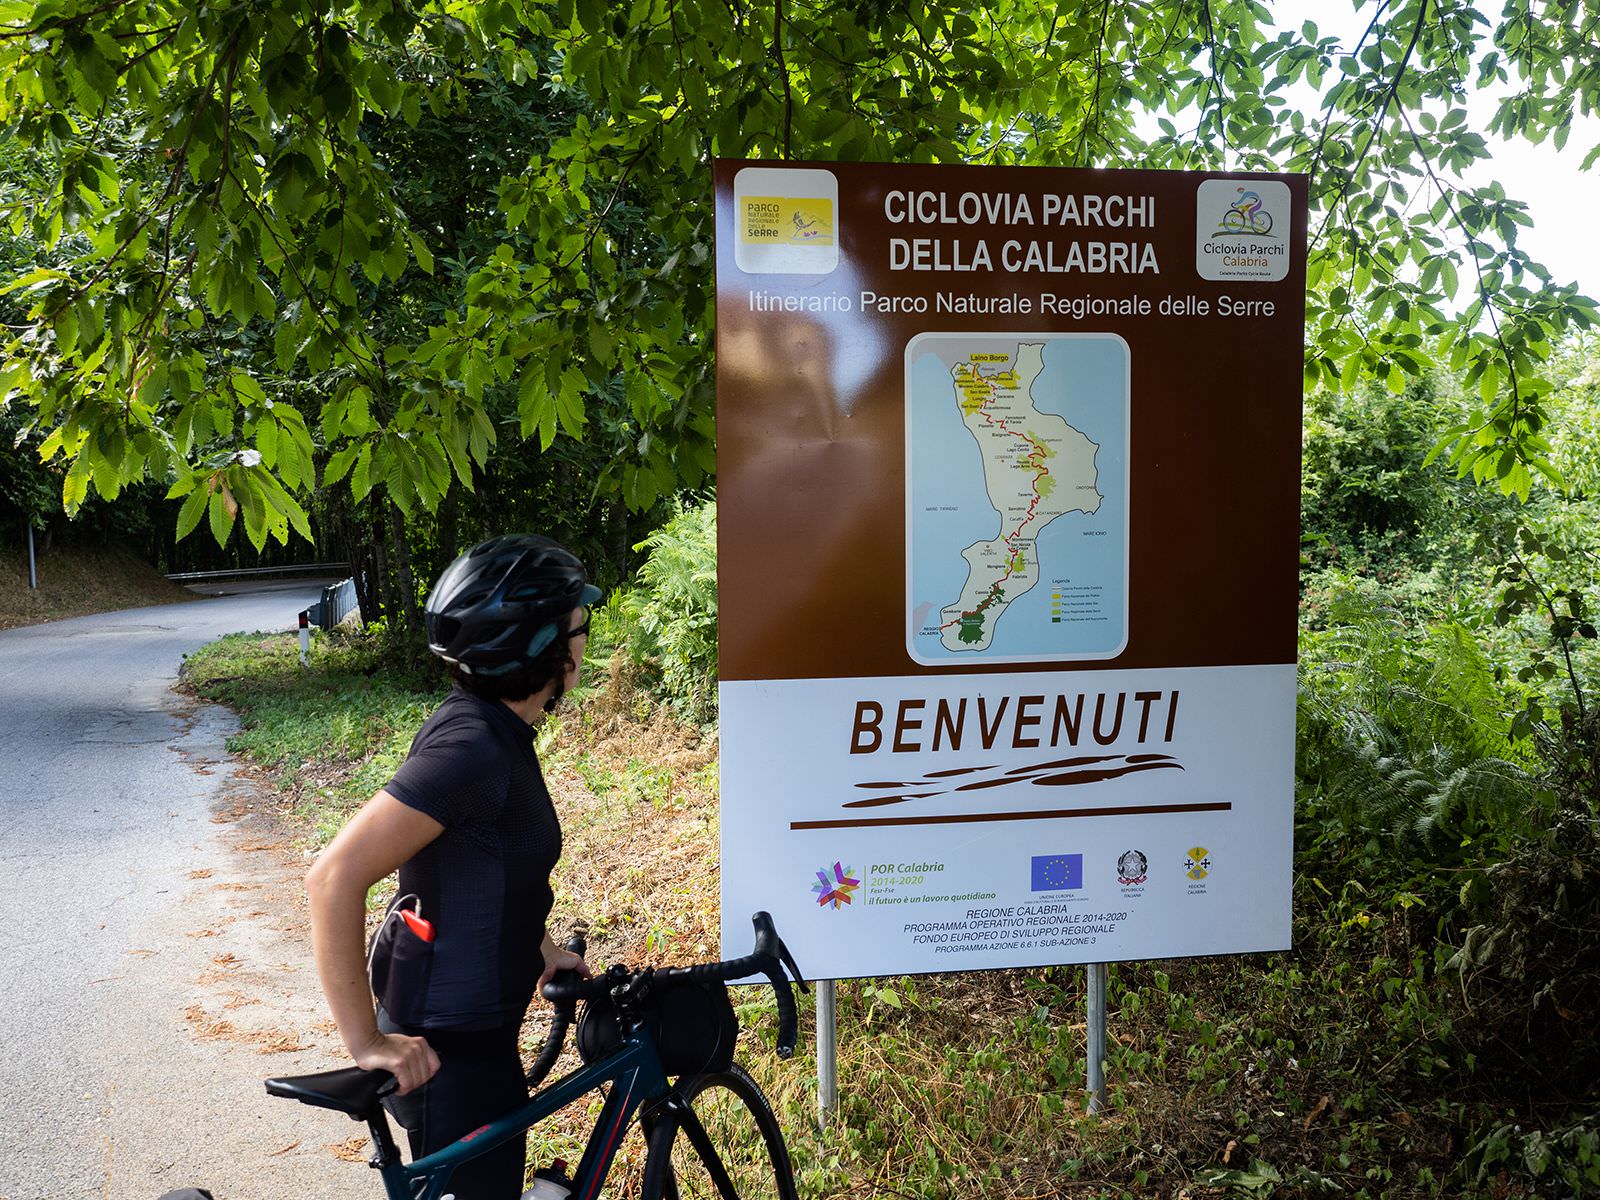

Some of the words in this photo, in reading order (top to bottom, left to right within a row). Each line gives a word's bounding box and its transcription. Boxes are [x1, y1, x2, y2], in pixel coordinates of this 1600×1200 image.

[885, 190, 1034, 226] CICLOVIA
[1043, 193, 1155, 228] PARCHI
[890, 238, 993, 272] DELLA
[1002, 239, 1160, 275] CALABRIA
[1204, 242, 1247, 254] Ciclovia
[1250, 244, 1284, 255] Parchi
[1223, 256, 1268, 267] Calabria
[750, 290, 851, 313] Itinerario
[861, 292, 928, 314] Parco
[936, 292, 1032, 315] Naturale
[1040, 294, 1151, 320] Regionale
[1159, 295, 1210, 317] delle
[1217, 296, 1275, 317] Serre
[849, 690, 1180, 755] BENVENUTI
[870, 864, 895, 874] POR
[897, 862, 944, 874] Calabria
[870, 876, 924, 886] 2014-2020
[874, 897, 902, 905] futuro
[922, 894, 950, 902] lavoro
[950, 892, 996, 902] quotidiano
[966, 908, 1014, 920] REGIONE
[1016, 904, 1068, 916] CALABRIA
[904, 922, 968, 933] PROGRAMMA
[968, 918, 1023, 930] OPERATIVO
[1026, 914, 1080, 926] REGIONALE
[1082, 912, 1128, 924] 2014-2020
[912, 933, 949, 944] FONDO
[950, 930, 998, 942] EUROPEO
[1000, 930, 1010, 940] DI
[1012, 926, 1059, 938] SVILUPPO
[1061, 924, 1116, 935] REGIONALE
[935, 943, 988, 954] PROGRAMMA
[988, 942, 1018, 951] AZIONE
[1020, 940, 1038, 949] 6.6.1
[1040, 938, 1090, 948] SUB-AZIONE
[1090, 936, 1096, 945] 3
